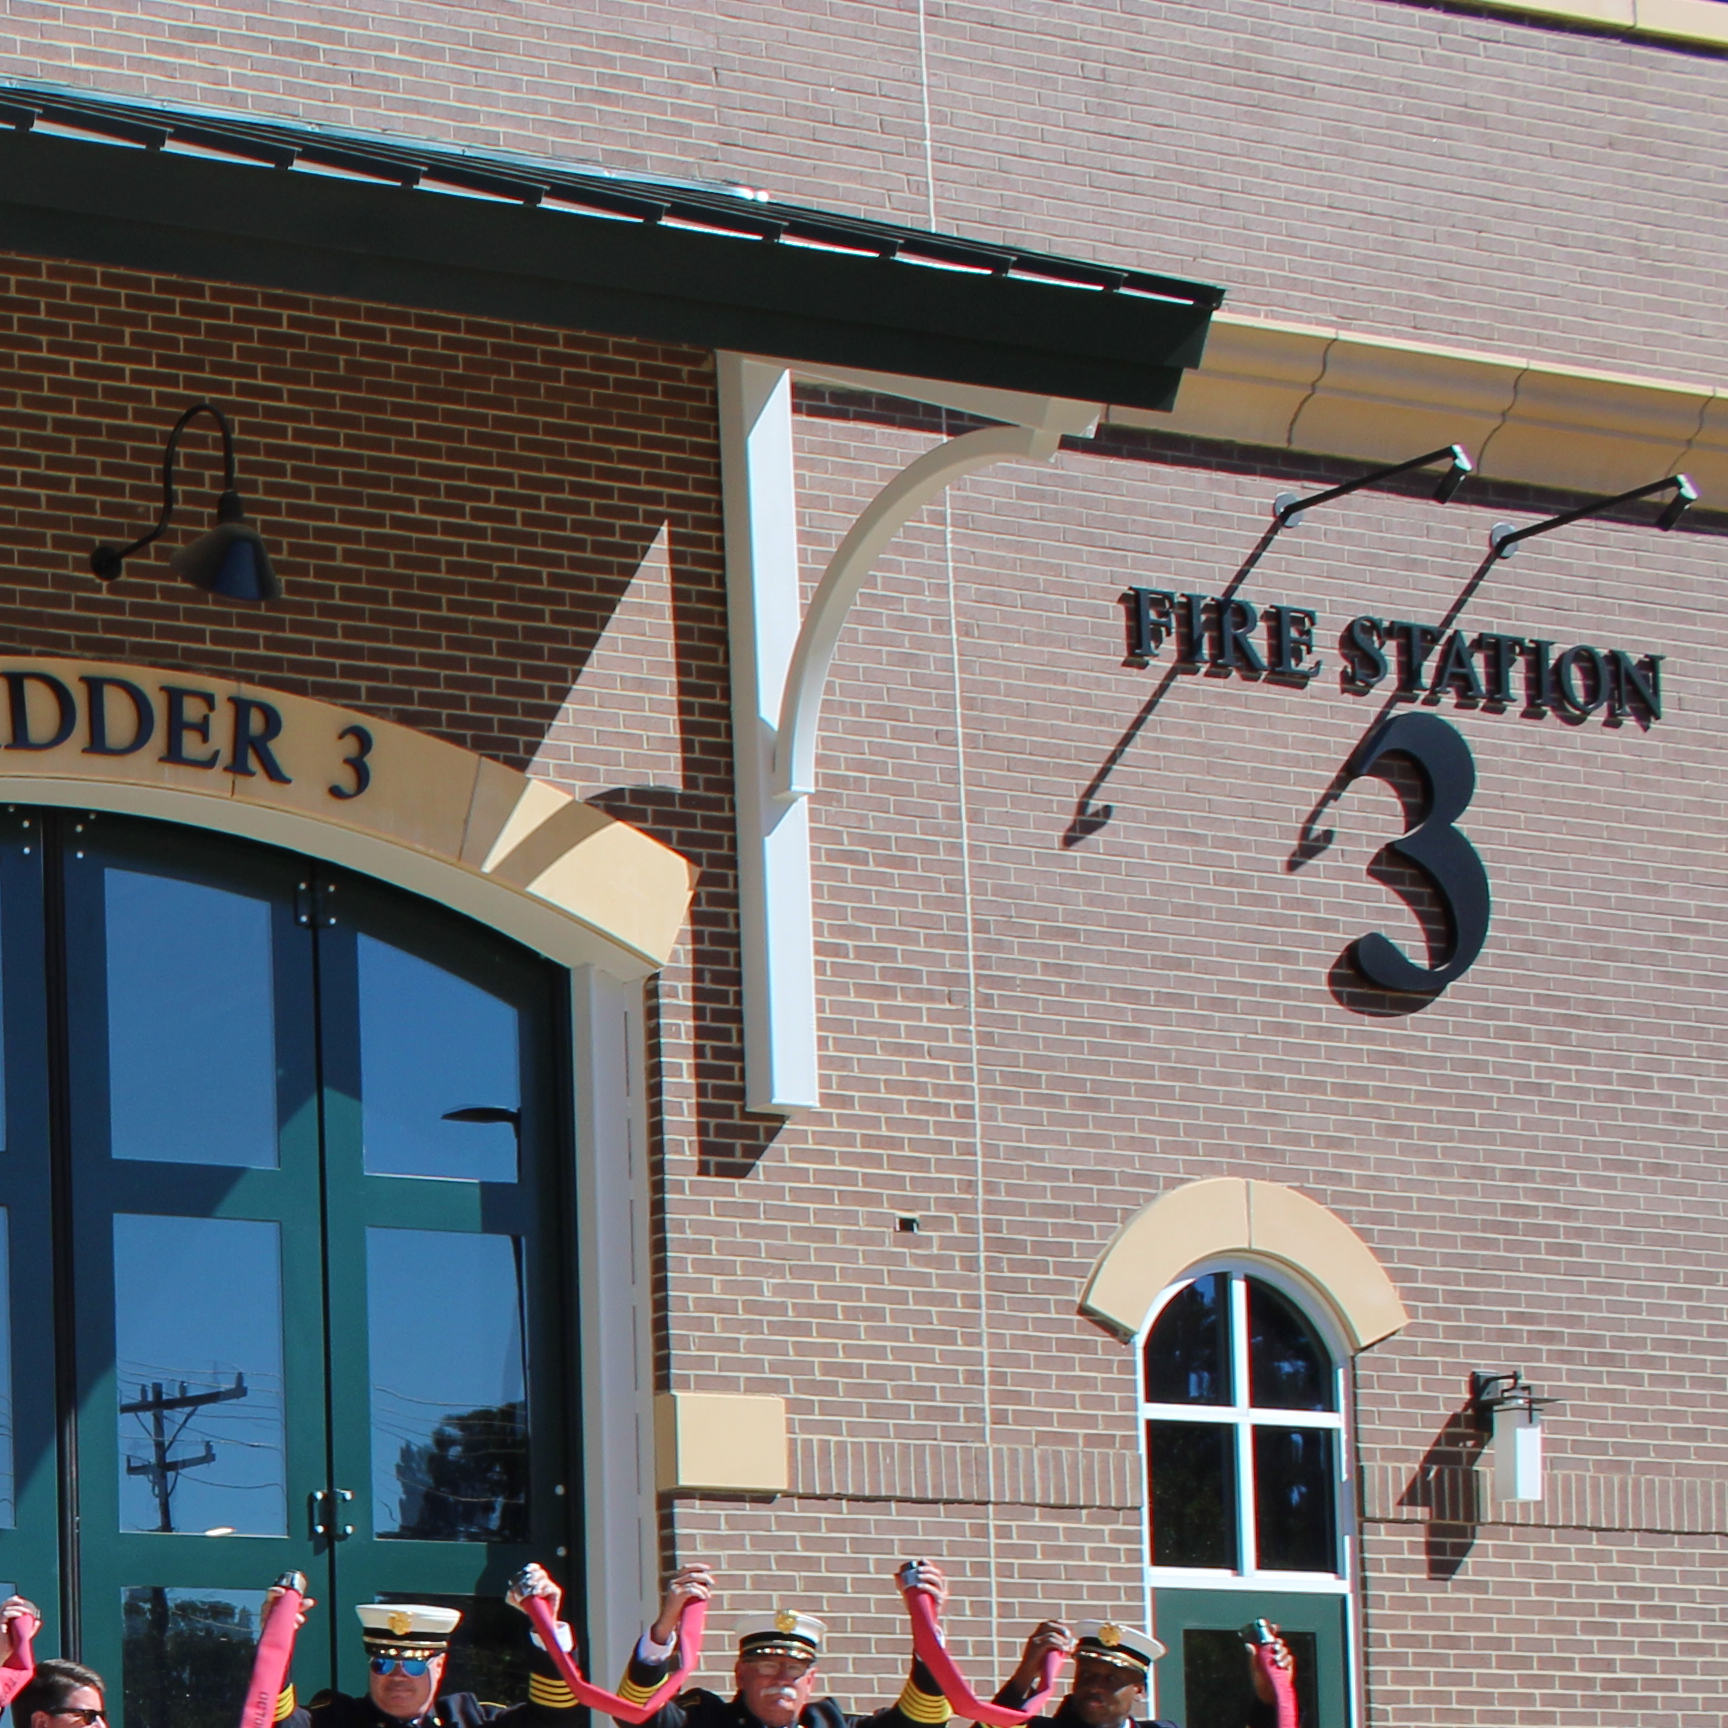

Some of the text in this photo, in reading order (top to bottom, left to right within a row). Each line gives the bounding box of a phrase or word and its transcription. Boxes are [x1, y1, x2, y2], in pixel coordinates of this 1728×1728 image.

[1123, 585, 1666, 723] FIRE STATION
[328, 724, 374, 800] 3
[1351, 711, 1491, 992] 3
